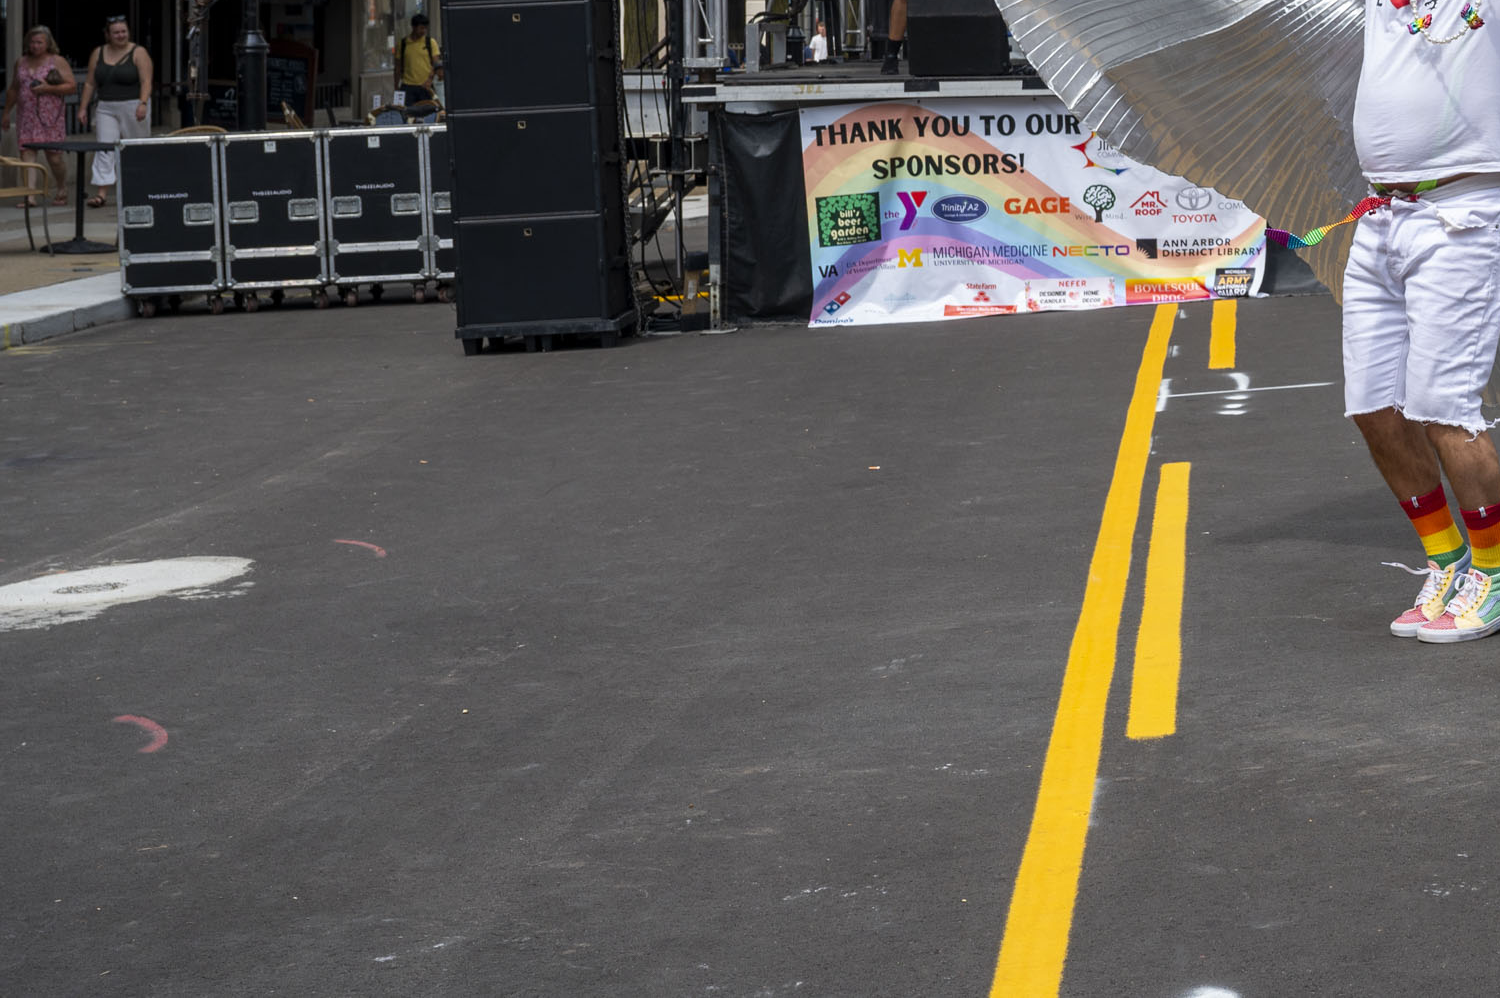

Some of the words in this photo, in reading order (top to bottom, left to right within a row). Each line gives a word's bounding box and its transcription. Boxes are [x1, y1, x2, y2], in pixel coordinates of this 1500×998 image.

[811, 117, 904, 147] THANK
[913, 115, 970, 138] YOU
[979, 114, 1016, 137] TO
[1025, 113, 1081, 136] OUR
[872, 153, 1025, 180] SPONSORS!
[941, 201, 967, 214] Trinity
[1004, 196, 1071, 215] GAGE
[884, 210, 900, 220] the
[1135, 208, 1162, 216] ROOF
[838, 217, 861, 228] beer
[1172, 213, 1217, 224] TOYOTA
[830, 226, 869, 241] garden
[1162, 238, 1188, 247] ANN
[1192, 237, 1231, 247] ARBOR
[933, 246, 989, 259] MICHIGAN
[993, 244, 1048, 258] MEDICINE
[1052, 245, 1130, 258] NECTO
[1162, 248, 1214, 258] DISTRICT
[1217, 247, 1263, 256] LIBRARY
[934, 259, 975, 267] UNIVERSITY
[988, 258, 1024, 266] MICHIGAN
[819, 265, 838, 279] VA
[1218, 276, 1250, 285] ARMY
